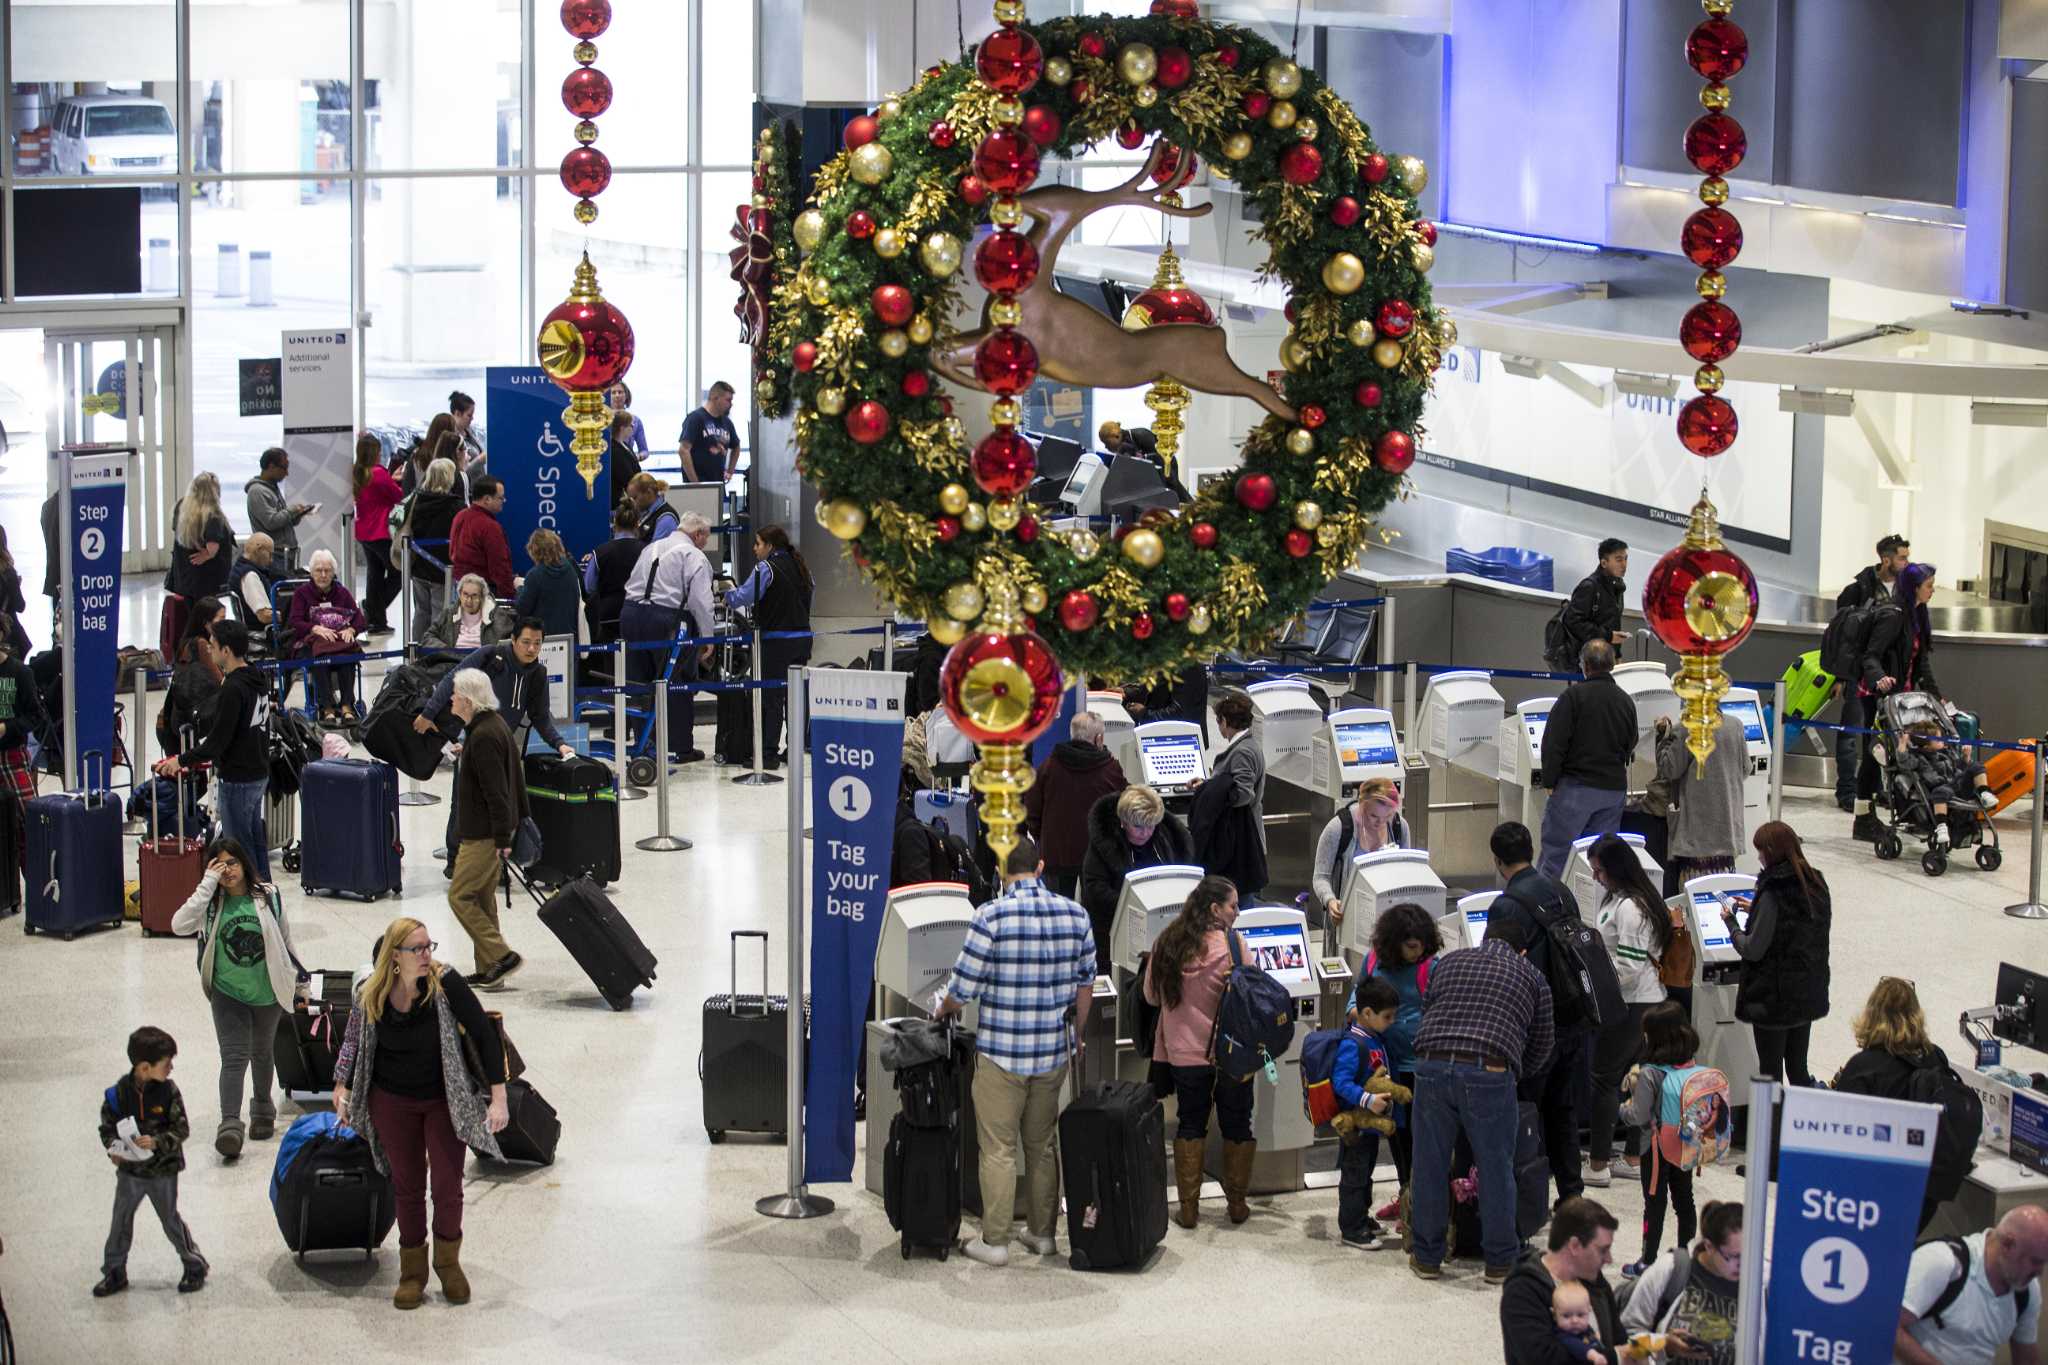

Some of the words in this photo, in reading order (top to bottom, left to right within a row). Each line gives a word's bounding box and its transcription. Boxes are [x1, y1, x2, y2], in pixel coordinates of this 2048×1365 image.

[289, 336, 333, 344] UNITED
[289, 353, 330, 362] Additional
[289, 365, 322, 373] services
[511, 375, 554, 385] UNIT
[74, 471, 102, 479] UNITED
[535, 466, 561, 534] Spec
[79, 505, 109, 521] Step
[1649, 508, 1665, 519] STAR
[87, 533, 99, 553] 2
[81, 574, 114, 590] Drop
[81, 594, 113, 612] your
[82, 614, 107, 630] bag
[815, 696, 863, 707] UNITED
[825, 743, 875, 770] Step
[842, 783, 857, 812] 1
[827, 840, 866, 866] Tag
[827, 871, 879, 891] your
[826, 895, 865, 922] bag
[1793, 1119, 1868, 1137] UNITED
[1801, 1187, 1880, 1231] Step
[1822, 1249, 1845, 1291] 1
[1792, 1328, 1852, 1365] Tag
